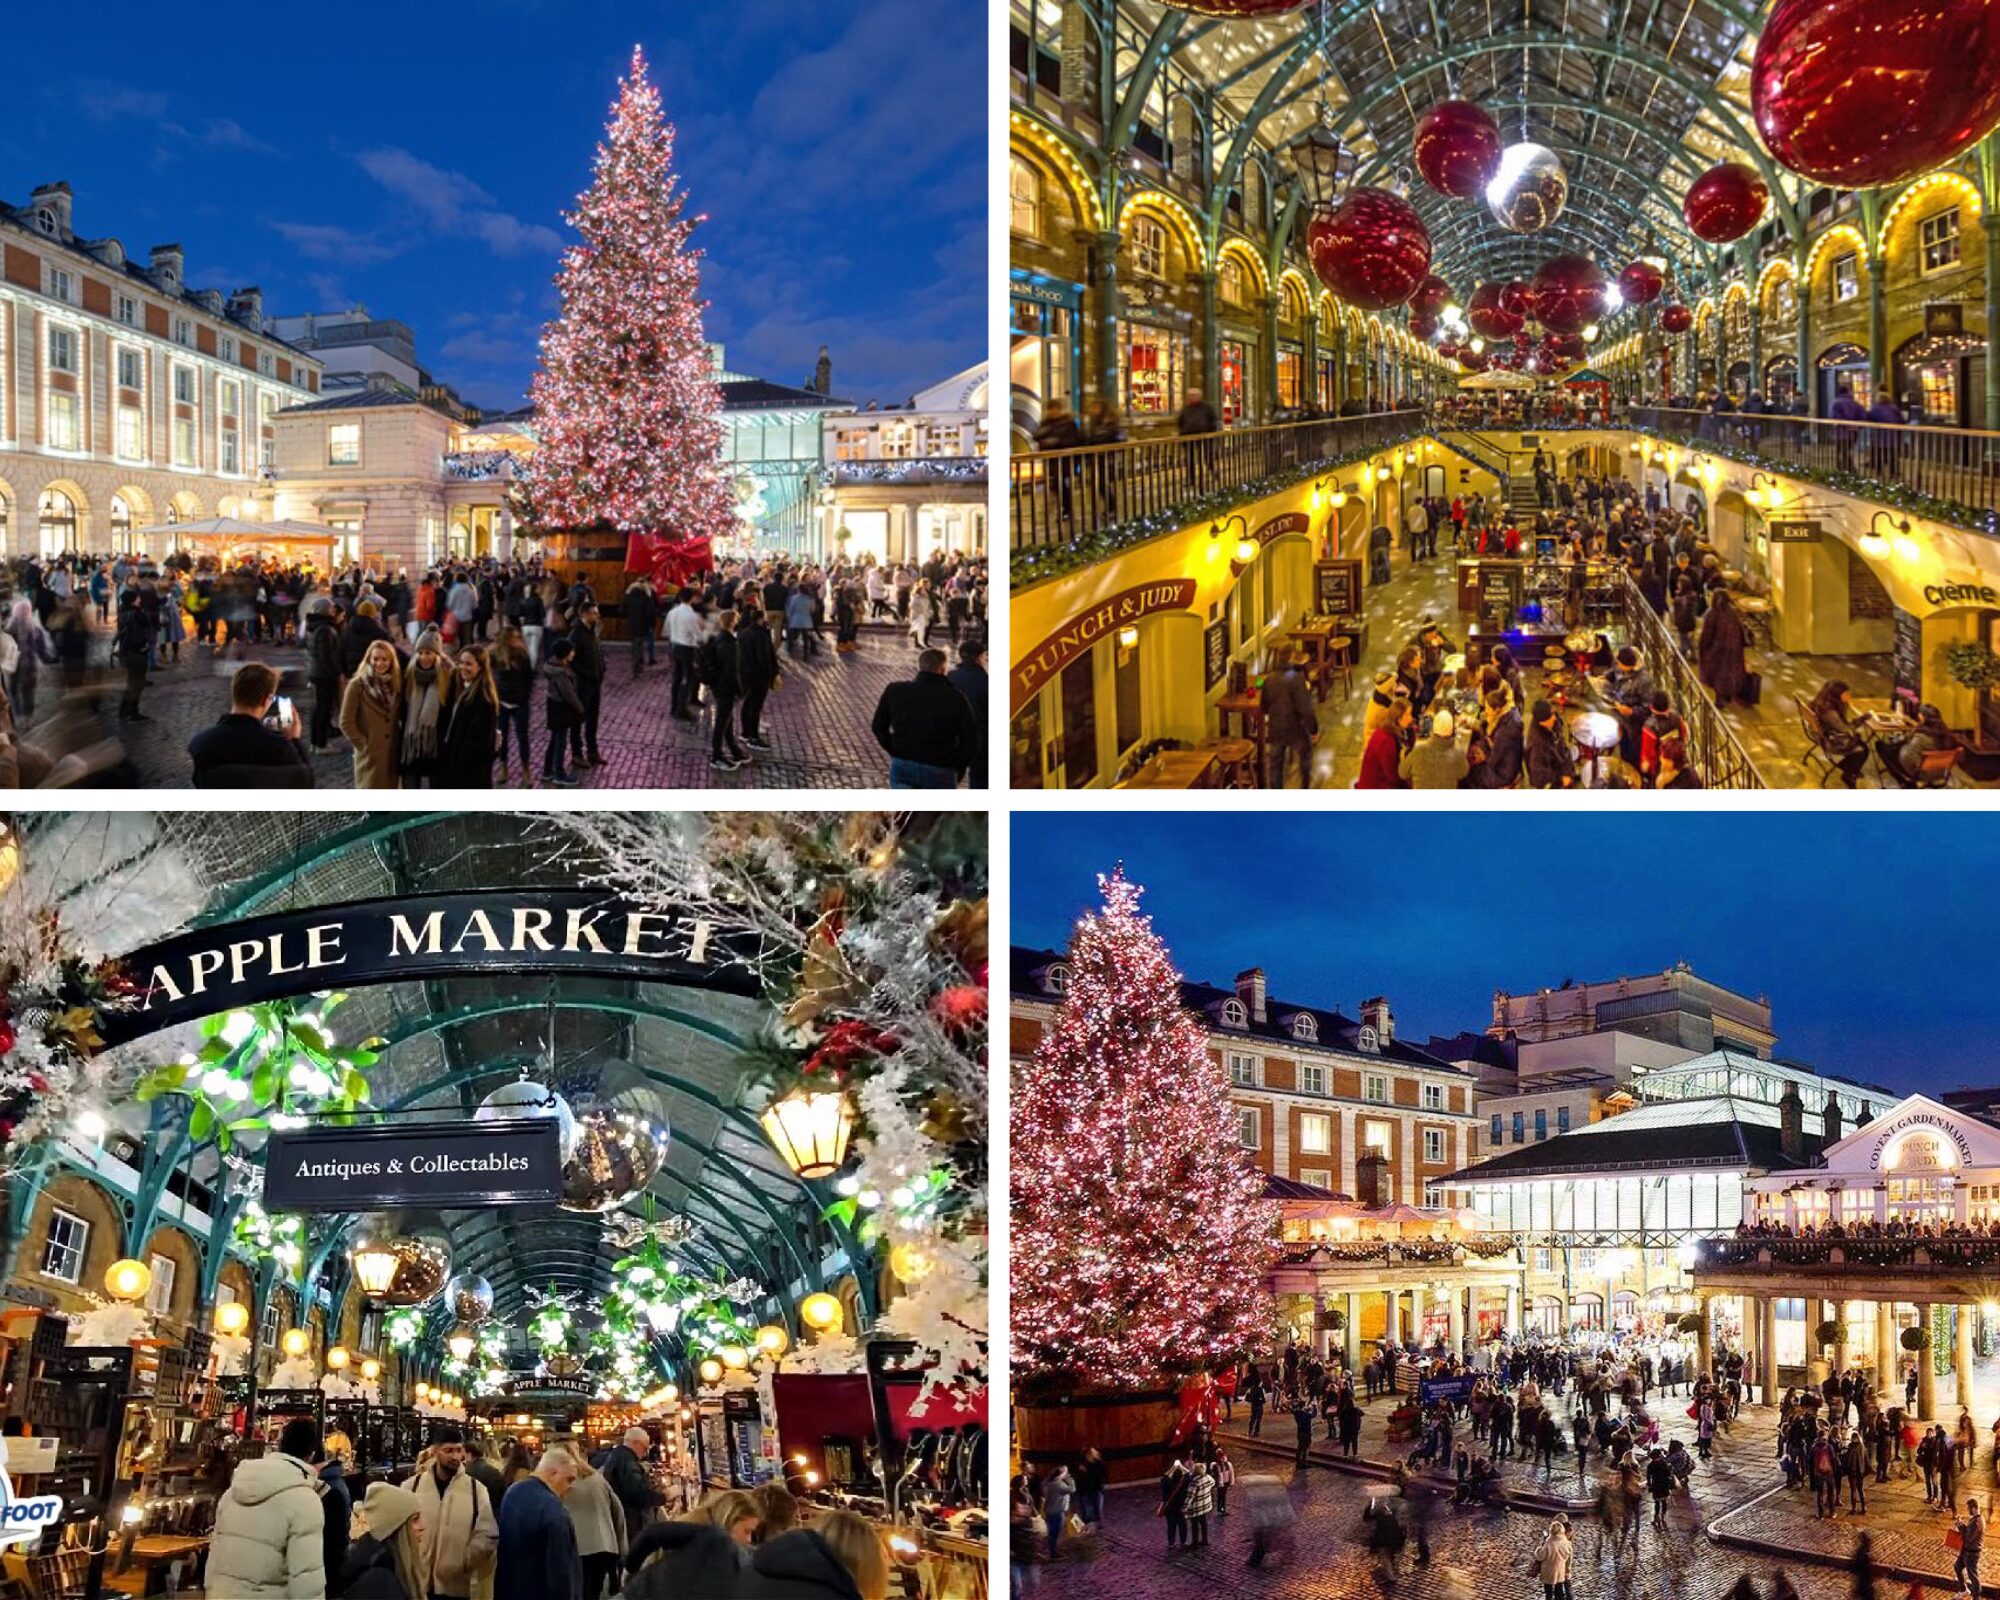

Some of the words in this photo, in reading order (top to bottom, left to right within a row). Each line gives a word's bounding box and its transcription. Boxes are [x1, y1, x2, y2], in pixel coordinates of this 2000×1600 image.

[1784, 526, 1809, 538] Exit
[1019, 605, 1114, 691] PUNCH
[1119, 598, 1135, 617] &
[1135, 584, 1184, 616] JUDY
[143, 922, 348, 1011] APPLE
[388, 907, 718, 964] MARKET
[1869, 1125, 1897, 1170] COVENT
[1897, 1113, 1945, 1129] GARDEN
[1943, 1120, 1974, 1169] MARKET
[295, 1158, 381, 1181] Antiques
[386, 1158, 404, 1174] &
[410, 1152, 530, 1174] Collectables
[514, 1379, 542, 1391] APPLE
[547, 1379, 590, 1392] MARKET
